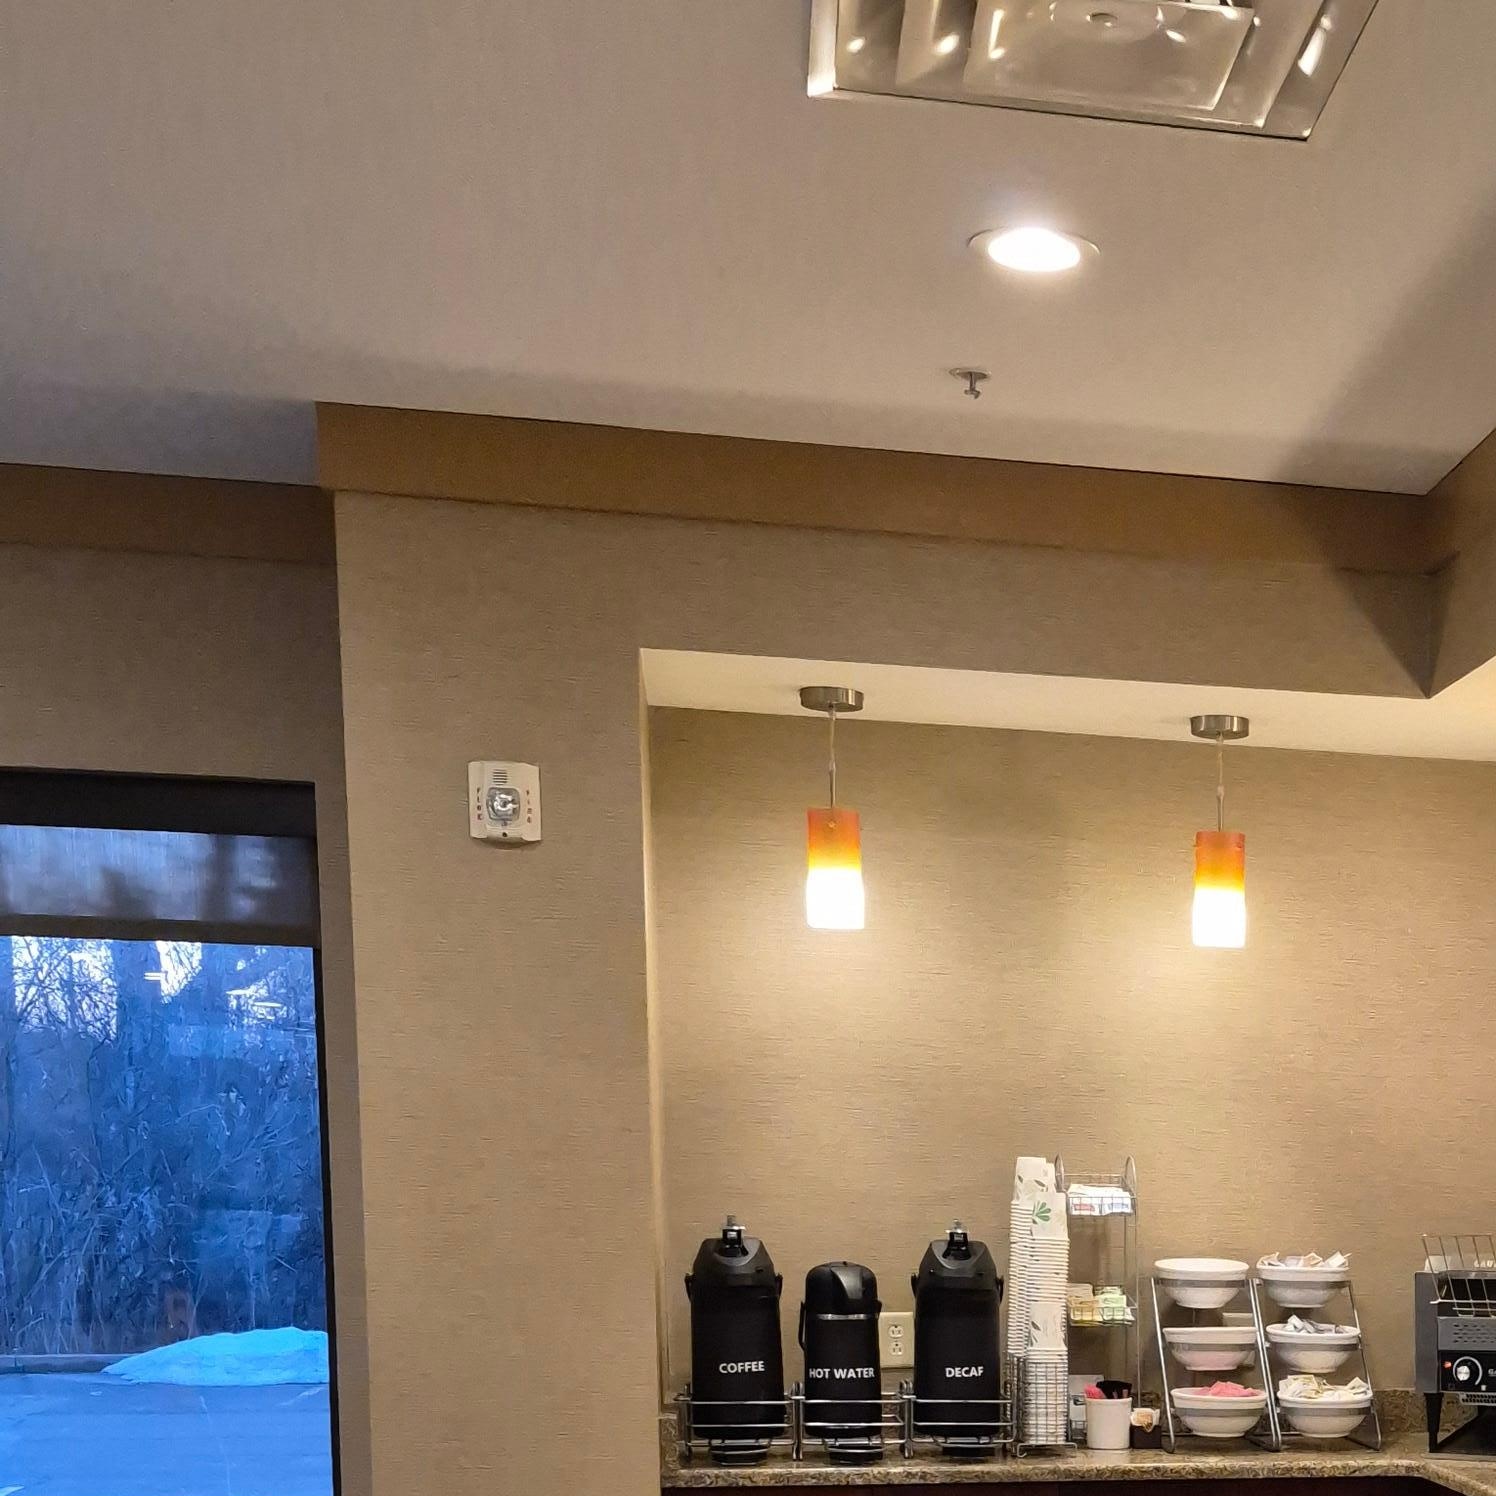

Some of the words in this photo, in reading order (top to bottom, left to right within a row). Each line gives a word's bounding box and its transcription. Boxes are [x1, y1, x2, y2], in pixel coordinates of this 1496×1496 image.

[719, 1360, 765, 1374] COFFEE
[809, 1367, 830, 1380] HOT
[833, 1367, 875, 1380] WATER
[945, 1365, 985, 1378] DECAF
